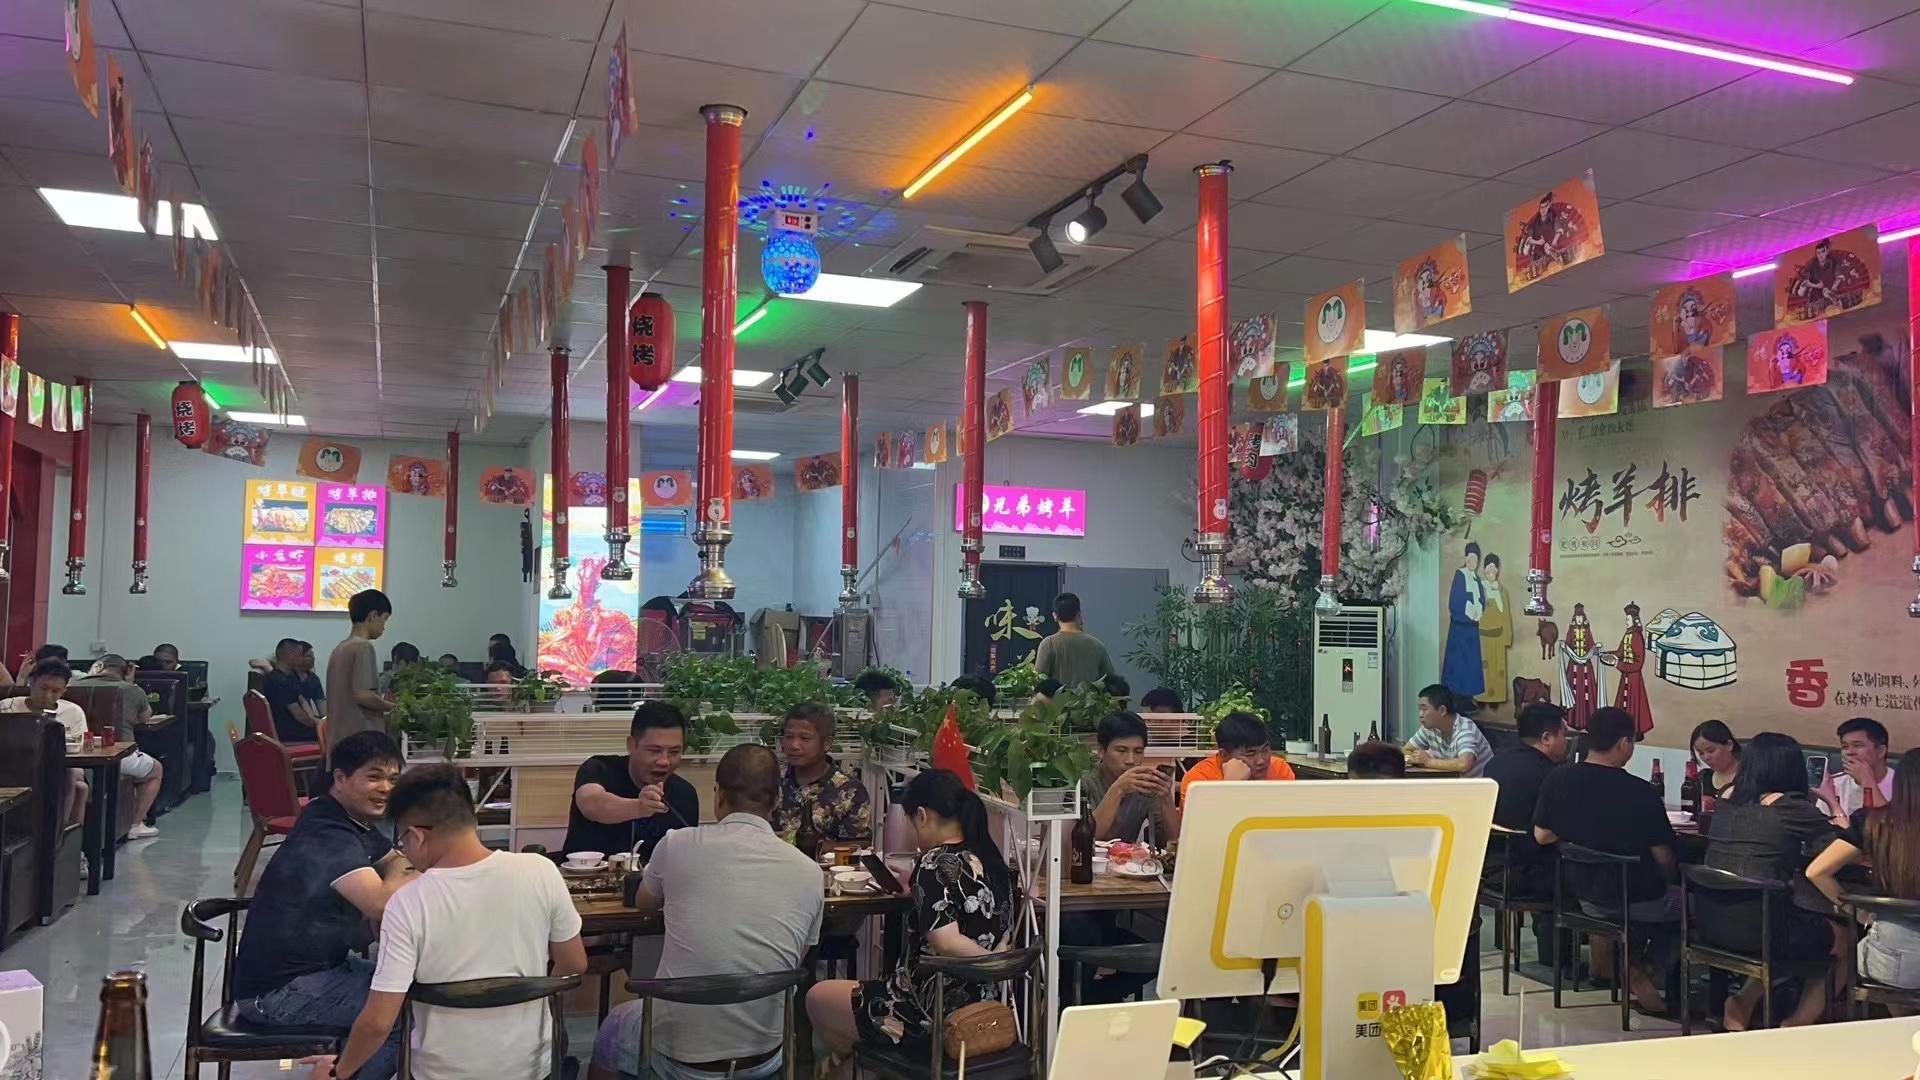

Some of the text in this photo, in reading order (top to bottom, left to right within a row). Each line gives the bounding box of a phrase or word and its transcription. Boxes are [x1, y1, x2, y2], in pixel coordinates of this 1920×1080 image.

[632, 315, 655, 365] 烧烤
[175, 401, 196, 436] 烧烤
[993, 493, 1076, 520] 兄弟烤羊
[1559, 459, 1702, 534] 烤羊排
[984, 598, 1044, 641] 味
[1785, 658, 1829, 709] 香
[1358, 1000, 1378, 1012] 美团
[1355, 1022, 1382, 1038] 美团
